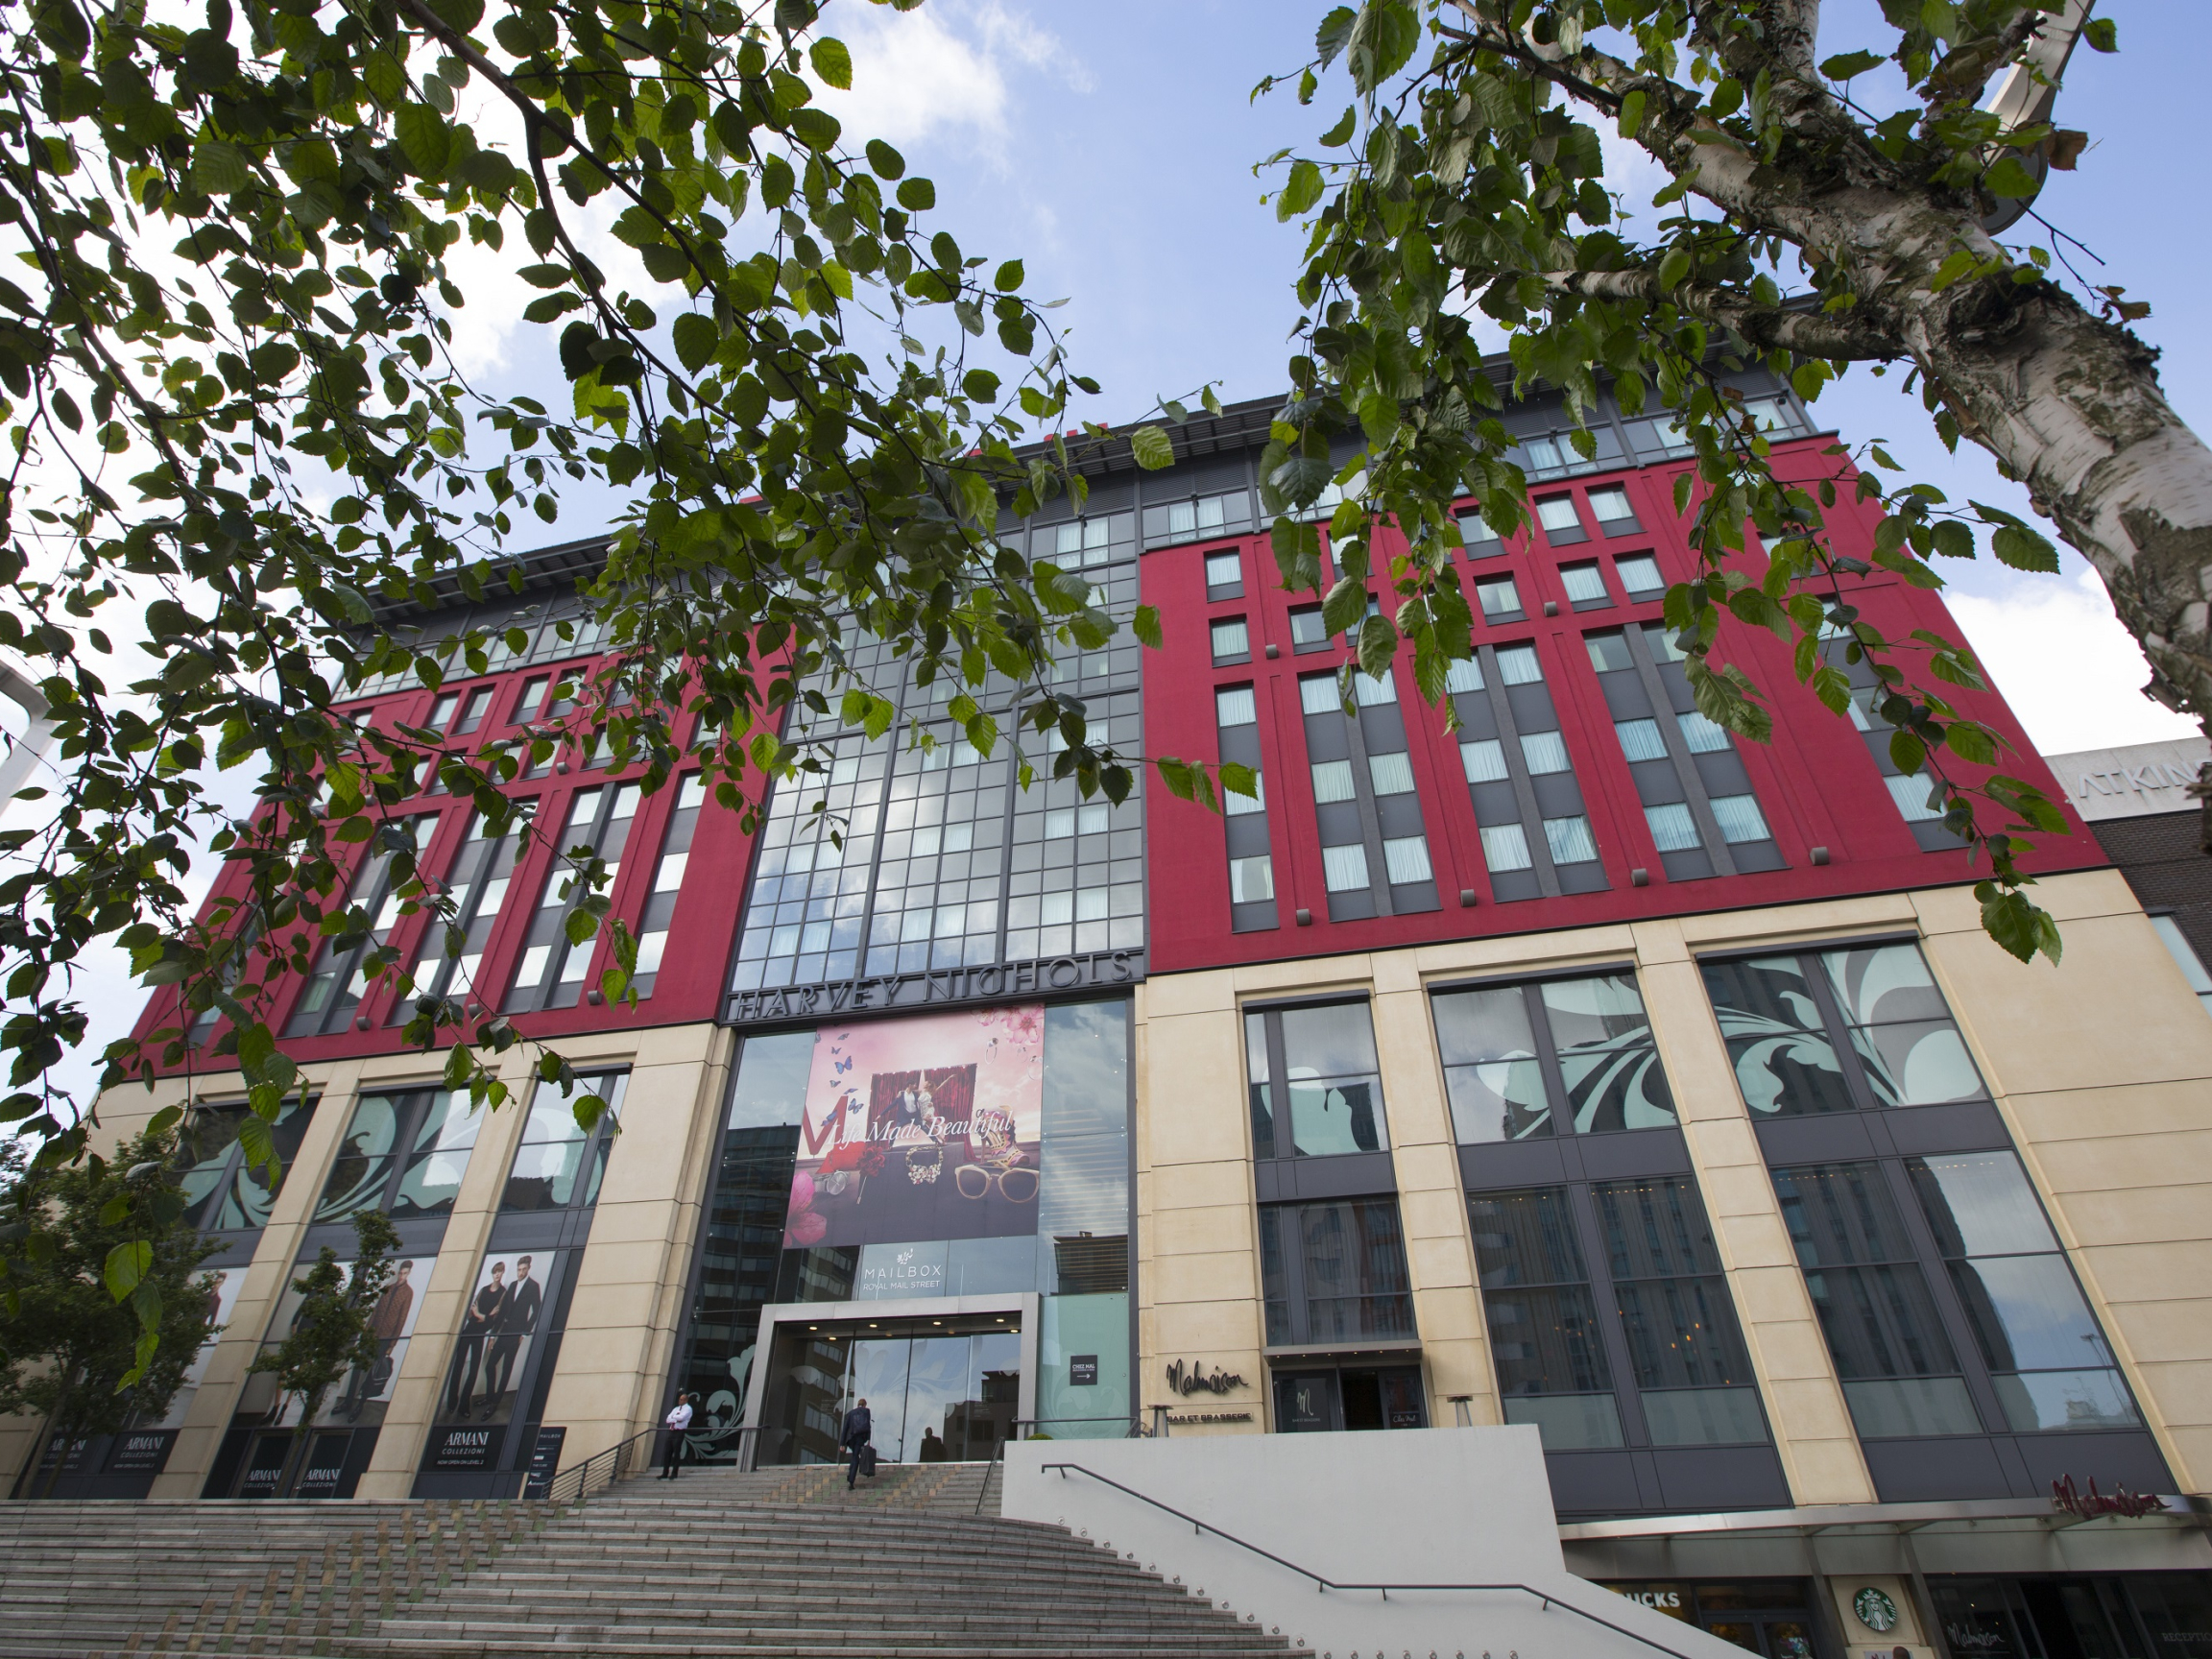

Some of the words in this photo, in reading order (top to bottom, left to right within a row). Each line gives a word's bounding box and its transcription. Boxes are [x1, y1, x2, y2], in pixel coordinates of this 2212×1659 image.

[734, 974, 902, 1021] HARVEY
[923, 950, 1131, 1002] NICHOLS
[826, 1121, 861, 1150] Life
[865, 1118, 922, 1142] Made
[926, 1111, 1013, 1140] Beautiful
[864, 1264, 942, 1280] MAILBOX
[863, 1283, 888, 1291] ROYAL
[910, 1280, 941, 1289] STREET
[1166, 1358, 1249, 1396] Malmaison
[1200, 1412, 1252, 1421] BRASSERIE
[124, 1436, 164, 1451] ARMANI
[444, 1431, 490, 1446] ARMANI
[304, 1468, 341, 1480] ARMANI
[1947, 1622, 2006, 1647] Malmaison
